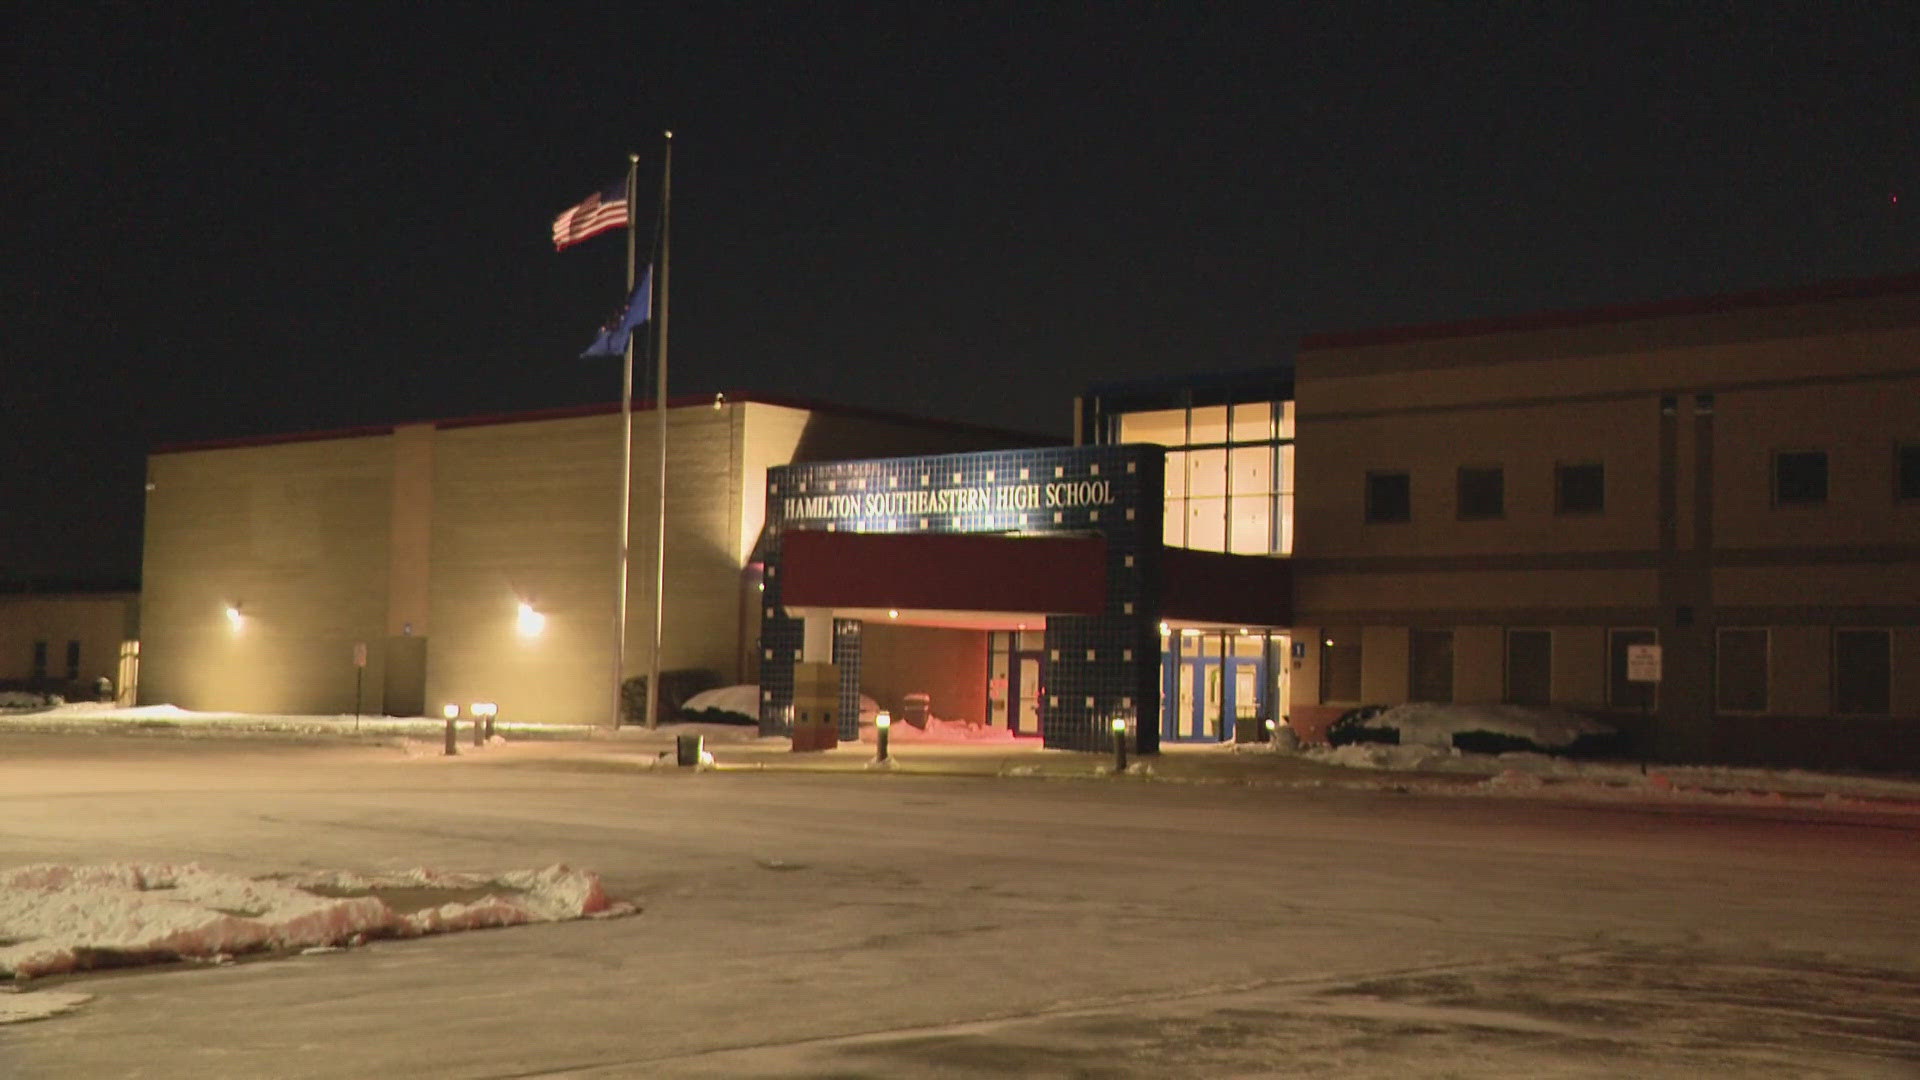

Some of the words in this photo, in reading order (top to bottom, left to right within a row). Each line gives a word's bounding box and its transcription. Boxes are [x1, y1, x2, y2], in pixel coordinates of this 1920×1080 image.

[785, 494, 861, 519] HAMILTON
[865, 485, 991, 517] SOUTHEASTERN
[995, 484, 1041, 510] HIGH
[1045, 480, 1115, 508] SCHOOL
